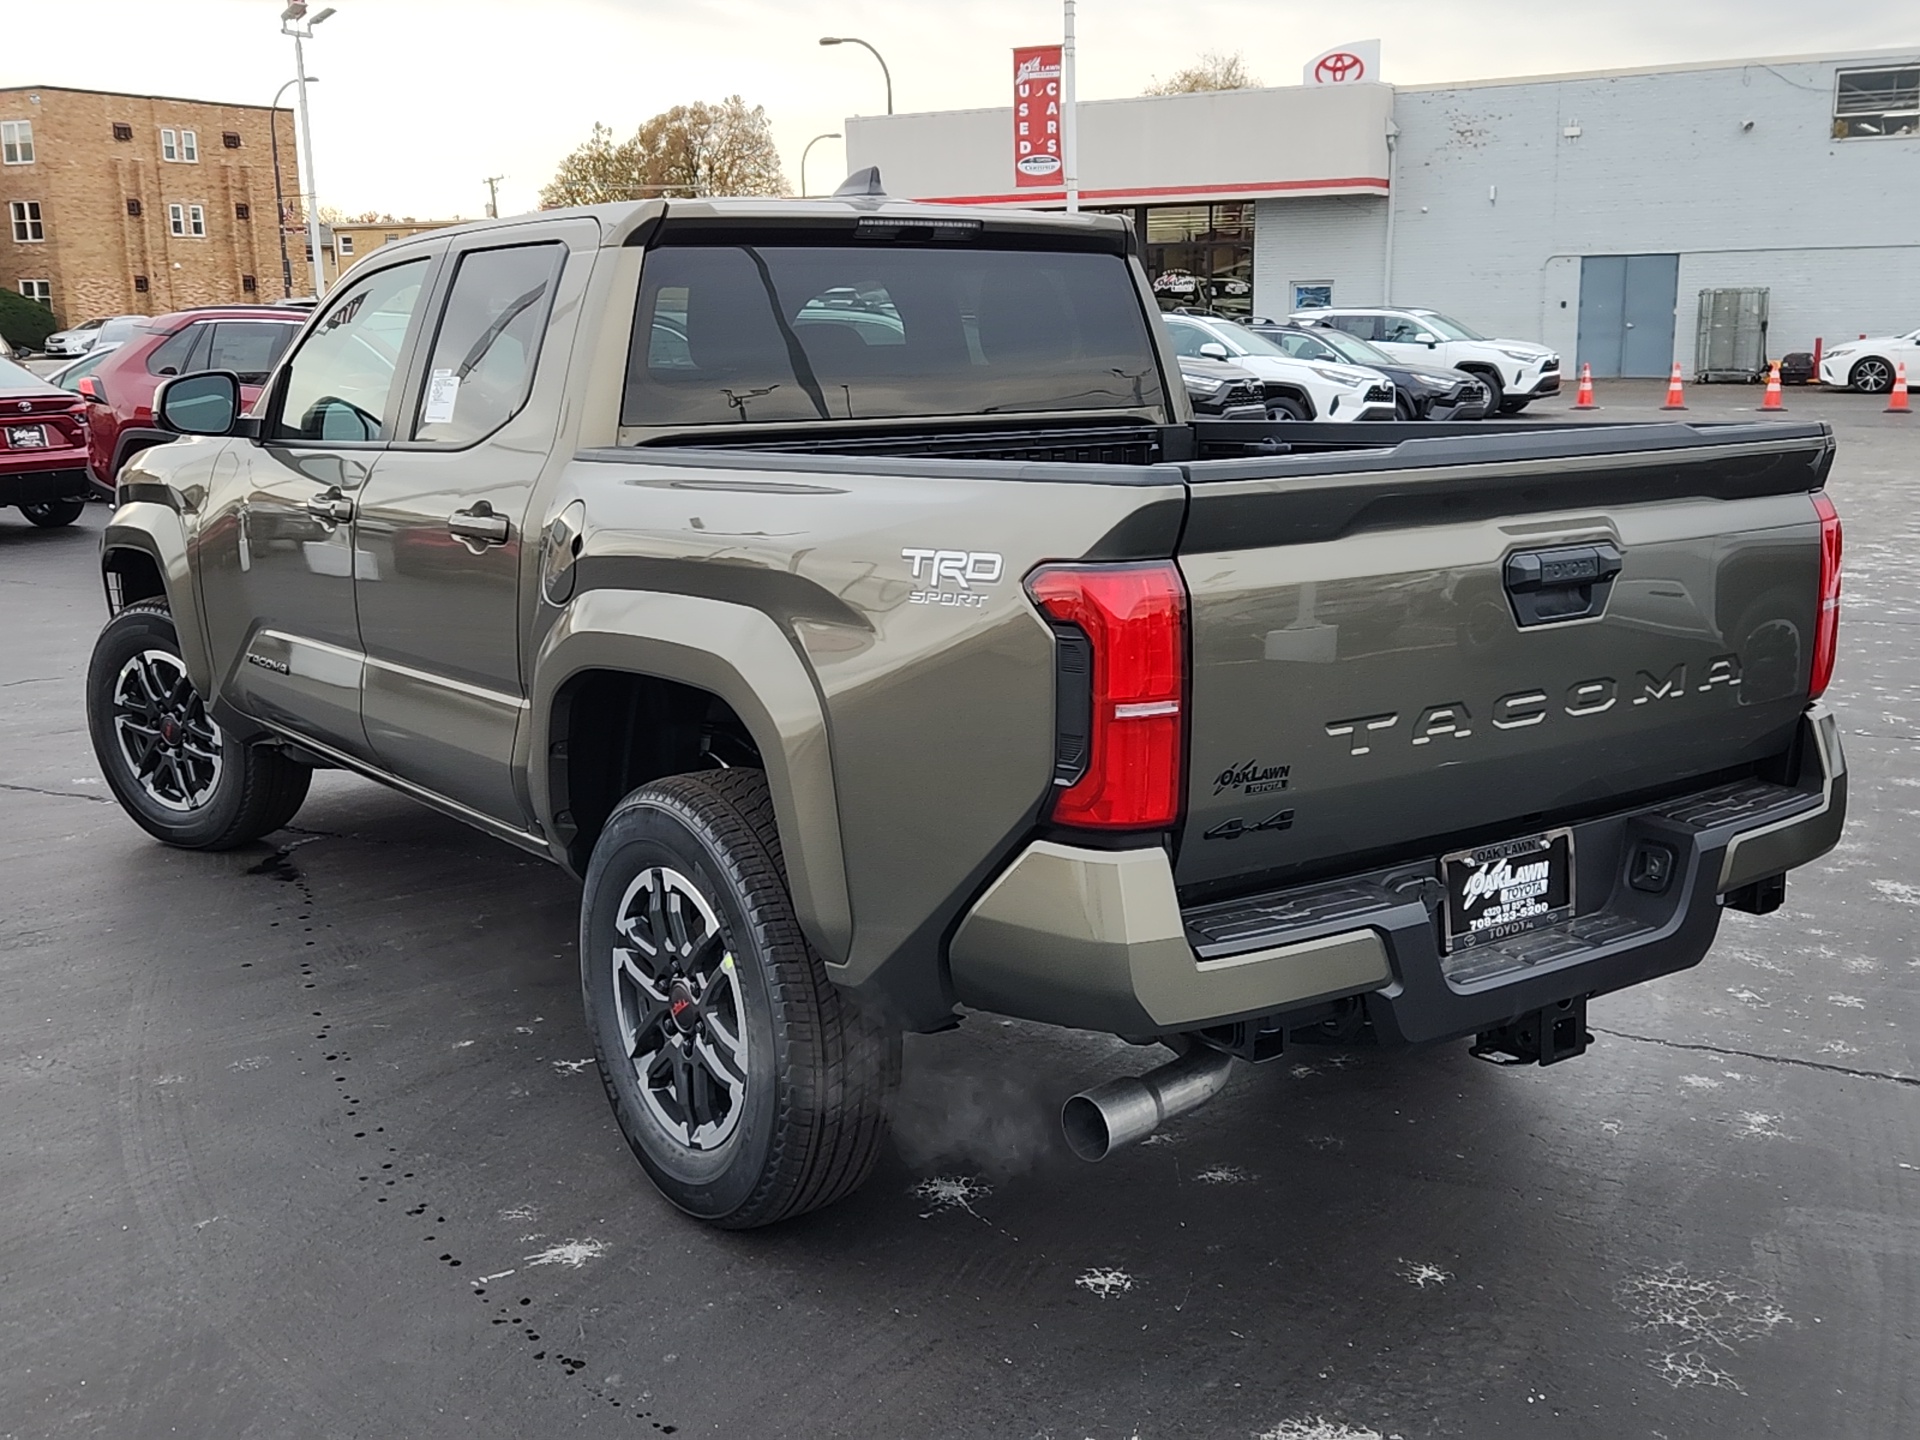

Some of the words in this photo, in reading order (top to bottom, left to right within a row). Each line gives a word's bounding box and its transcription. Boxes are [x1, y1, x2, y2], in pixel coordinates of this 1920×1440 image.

[1018, 84, 1031, 154] USED
[1046, 83, 1058, 153] CARS
[901, 547, 1003, 590] TRD
[908, 591, 989, 608] SPORT
[246, 652, 290, 676] TACOMA
[1324, 653, 1743, 756] TACOMA
[1477, 850, 1500, 861] OAK
[1504, 840, 1536, 856] LAWN
[1505, 882, 1543, 898] TOYOTA
[1469, 902, 1549, 932] 708-423-5200
[1488, 920, 1534, 939] TOYOTA
